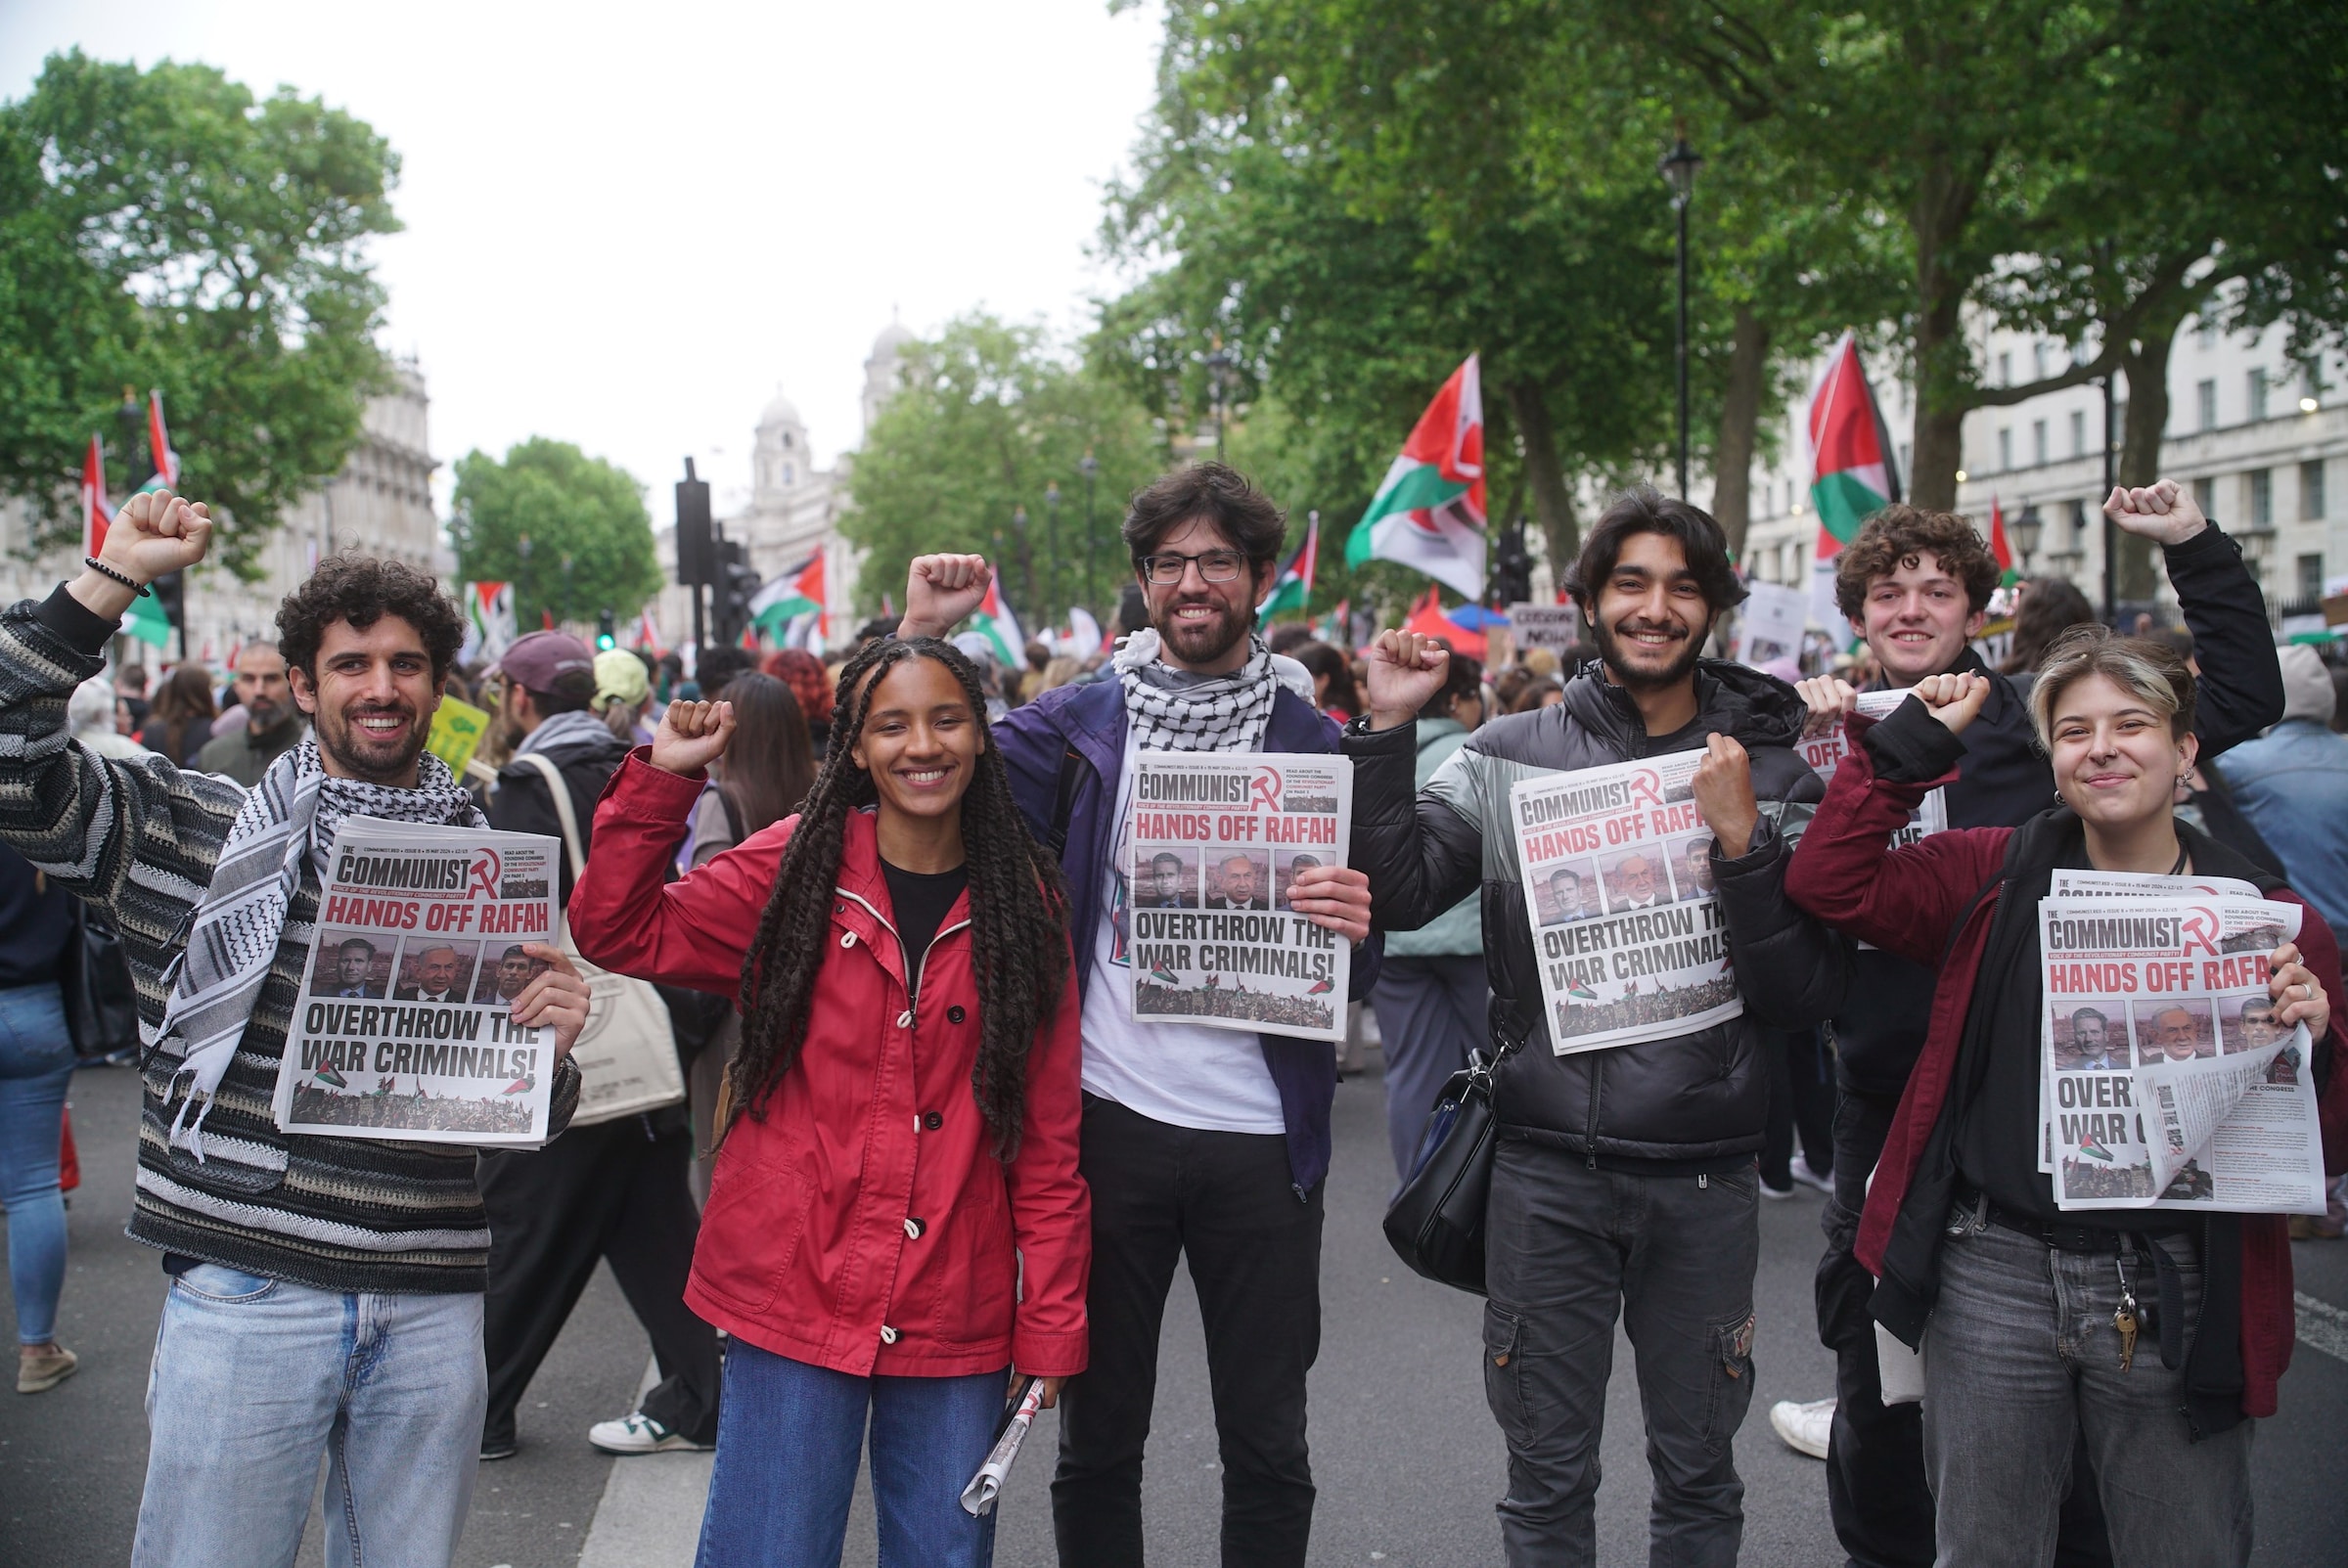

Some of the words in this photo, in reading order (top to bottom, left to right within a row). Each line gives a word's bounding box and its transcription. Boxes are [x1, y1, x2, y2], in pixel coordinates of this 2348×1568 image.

[1807, 742, 1842, 768] OFF
[1139, 773, 1251, 802] COMMUNIST
[1520, 780, 1630, 826] COMMUNIST
[1136, 813, 1211, 841] HANDS
[1218, 815, 1259, 841] OFF
[1265, 817, 1336, 844] RAFAH
[1525, 826, 1601, 863] HANDS
[1606, 813, 1646, 846] OFF
[1651, 803, 1712, 836] RAFA
[343, 845, 355, 854] THE
[337, 855, 471, 889] COMMUNIST
[2059, 879, 2069, 887] THE
[325, 895, 419, 929] HANDS
[425, 903, 476, 931] OFF
[479, 903, 548, 933] RAFAH
[1136, 912, 1286, 944] OVERTHROW
[1293, 919, 1336, 949] THE
[1543, 907, 1694, 960] OVERTHROW
[1699, 900, 1727, 930] TH
[2048, 910, 2058, 919] THE
[2049, 917, 2182, 949] COMMUNIST
[1137, 944, 1191, 970] WAR
[1199, 944, 1335, 982] CRIMINALS!
[1549, 956, 1608, 991] WAR
[1613, 930, 1733, 980] CRIMINALS
[2050, 962, 2137, 993] HANDS
[2145, 960, 2194, 992] OFF
[2203, 955, 2271, 990] RAFA
[305, 1003, 482, 1040] OVERTHROW
[491, 1012, 539, 1044] THE
[301, 1039, 366, 1072] WAR
[374, 1044, 537, 1080] CRIMINALS!
[2058, 1075, 2134, 1109] OVER
[2157, 1085, 2175, 1109] BUILD
[2060, 1114, 2128, 1145] WAR
[2162, 1110, 2179, 1126] THE
[2167, 1129, 2184, 1147] RCP
